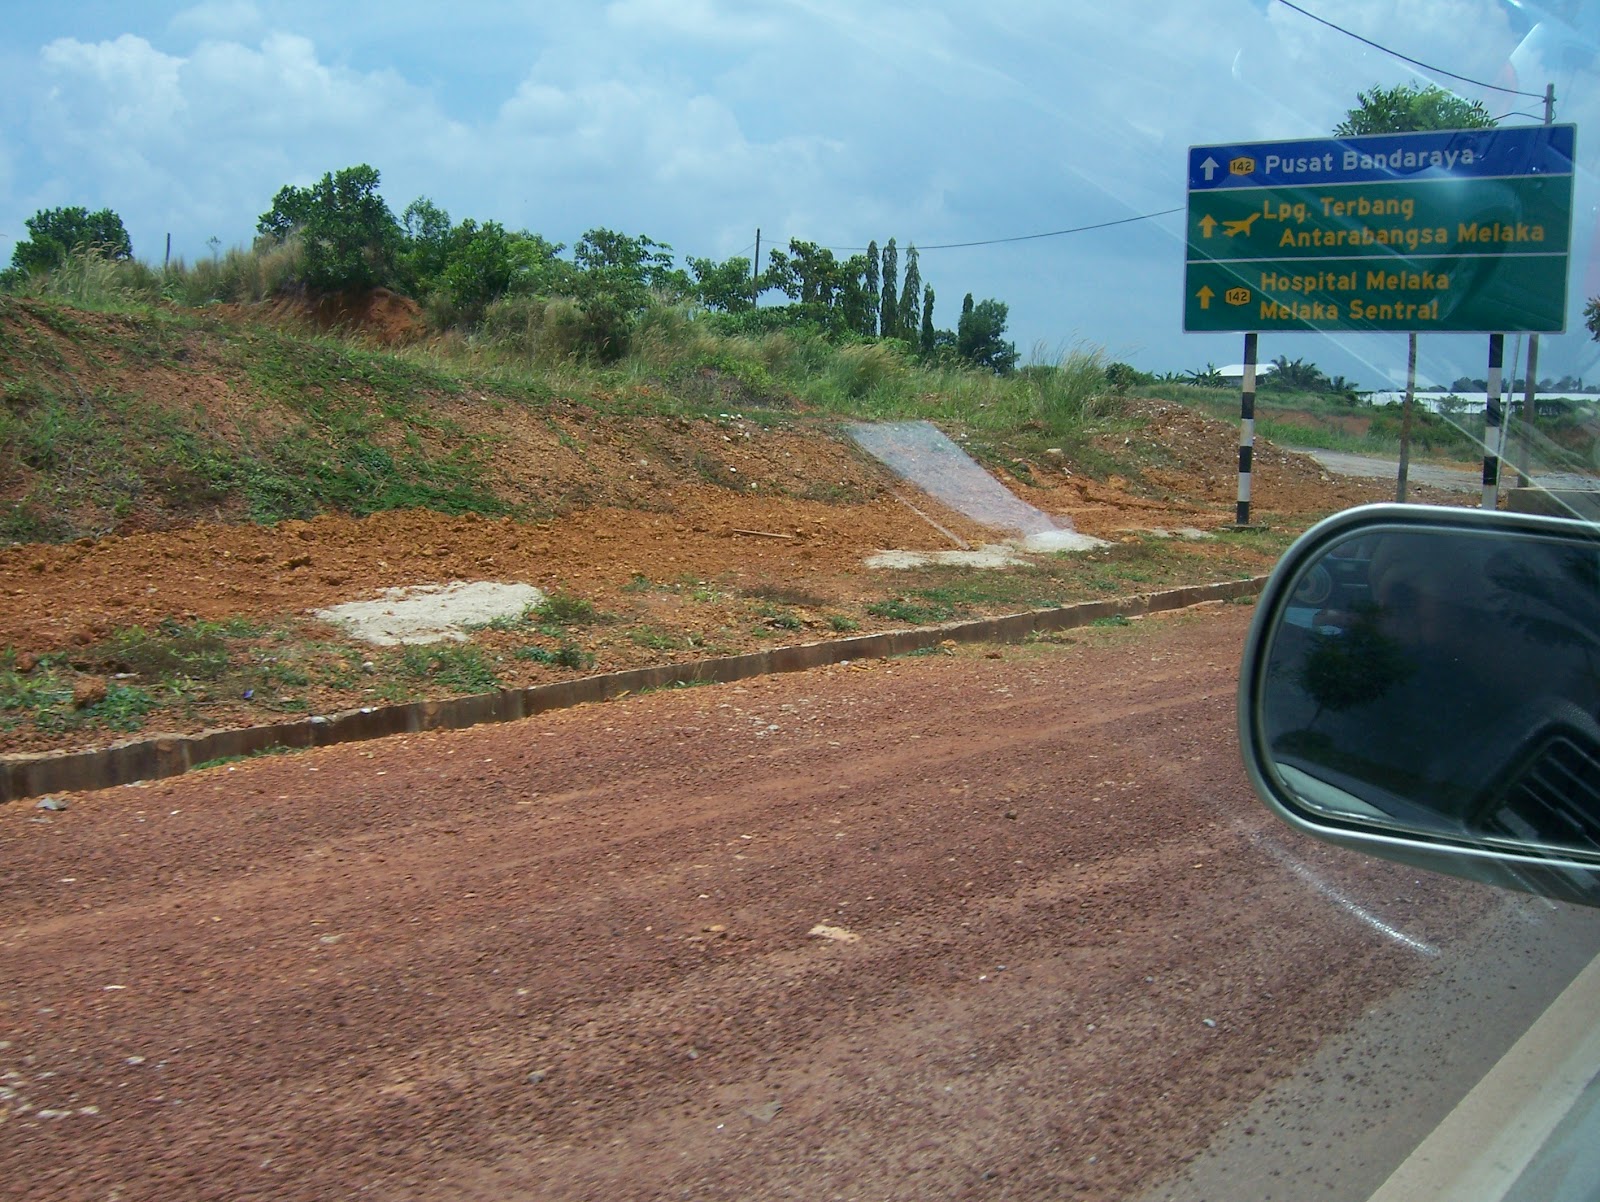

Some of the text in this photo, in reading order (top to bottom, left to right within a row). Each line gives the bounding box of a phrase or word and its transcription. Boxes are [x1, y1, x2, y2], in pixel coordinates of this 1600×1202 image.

[1232, 160, 1252, 172] 142
[1265, 147, 1475, 174] Pusat Bandaraya
[1263, 197, 1414, 223] Lpg. Terbang
[1279, 223, 1545, 250] Antarabangsa Melaka
[1260, 271, 1449, 294] Hospital Melaka
[1228, 290, 1248, 302] 142
[1260, 299, 1438, 320] Melaka Sentral
